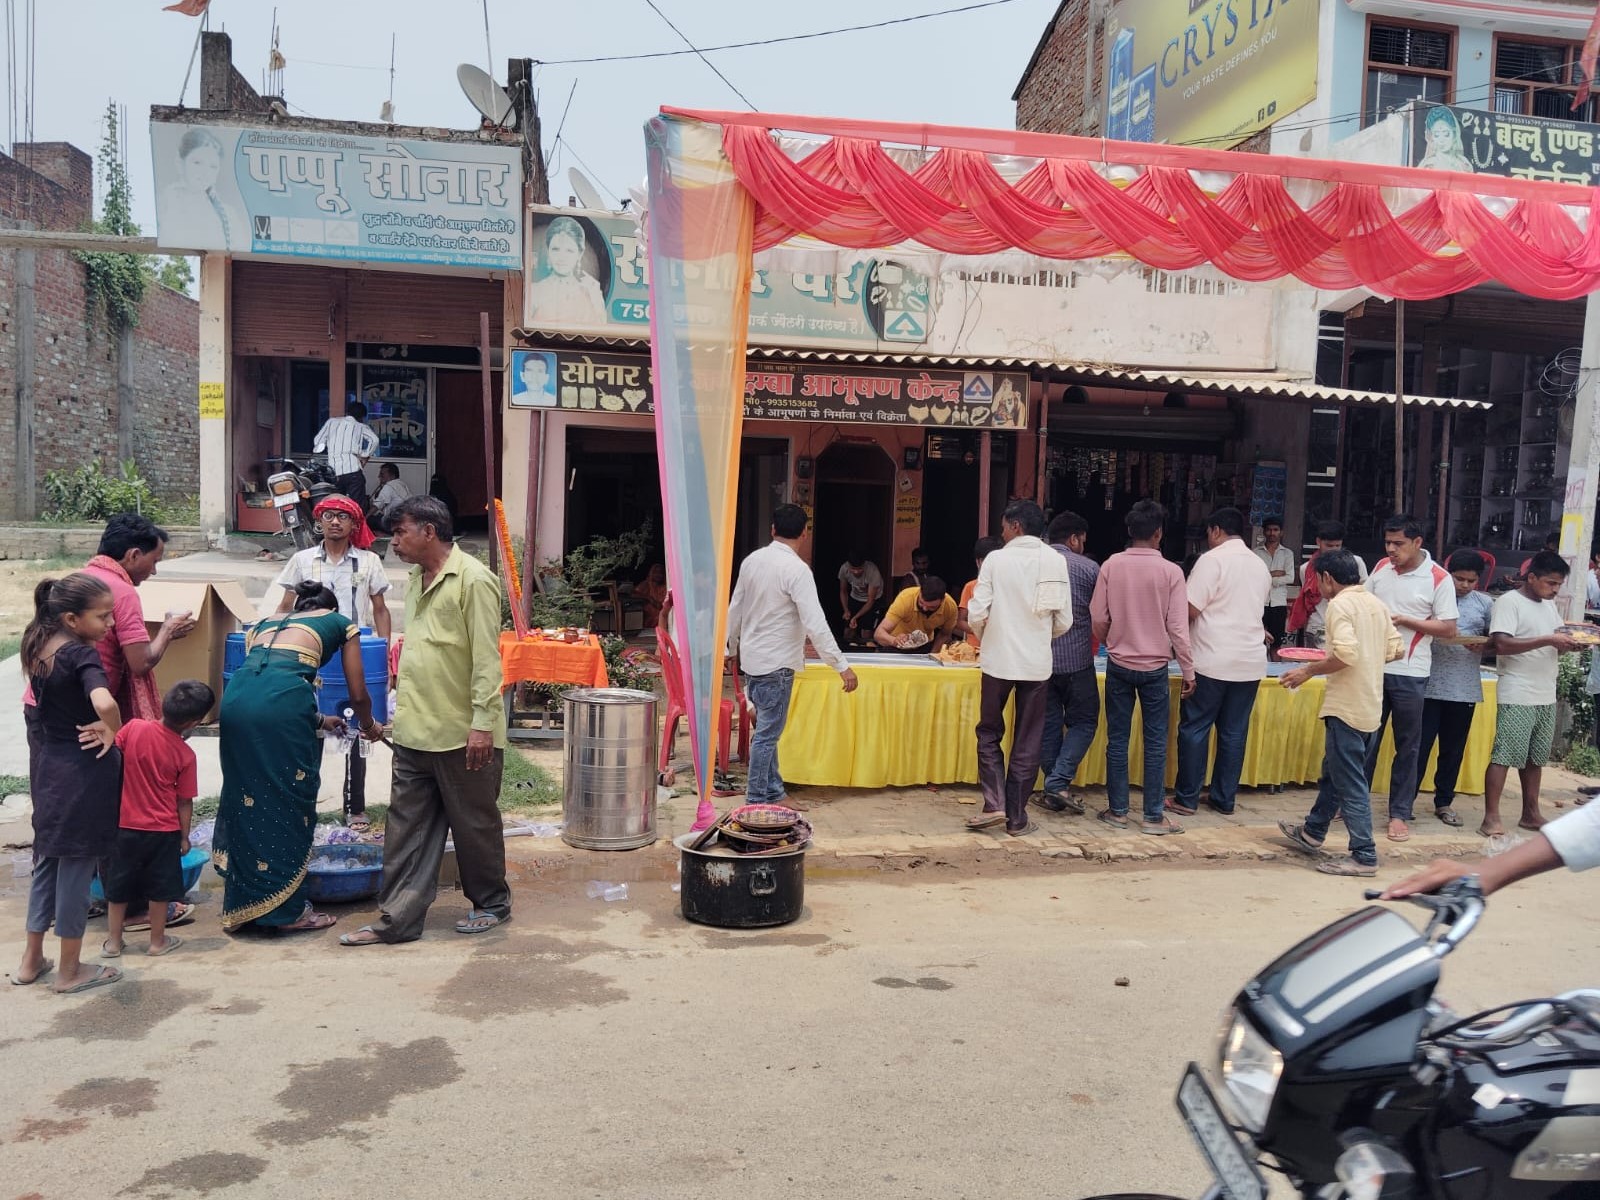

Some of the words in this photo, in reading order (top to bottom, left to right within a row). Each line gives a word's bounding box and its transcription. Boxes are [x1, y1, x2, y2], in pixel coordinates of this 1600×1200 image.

[1183, 82, 1201, 99] YOUR
[1202, 65, 1224, 86] TASTE
[1226, 42, 1258, 71] DEFINES
[1260, 27, 1278, 49] YOU
[1495, 122, 1546, 163] बब्लू
[1546, 128, 1593, 157] एण्ड
[243, 147, 351, 213] पप्पू
[359, 142, 509, 208] सोनार
[434, 215, 447, 229] के
[447, 219, 480, 234] आभूषण
[480, 218, 506, 233] मिलते
[418, 236, 432, 248] पर
[560, 355, 642, 387] सोनार
[800, 374, 903, 406] आभूषण
[907, 372, 962, 404] केन्द्र
[754, 405, 764, 417] के
[767, 406, 806, 420] आभूषणों
[810, 408, 820, 419] के
[823, 407, 856, 420] निर्माता
[859, 411, 873, 422] एवं
[877, 409, 907, 422] विक्रेता
